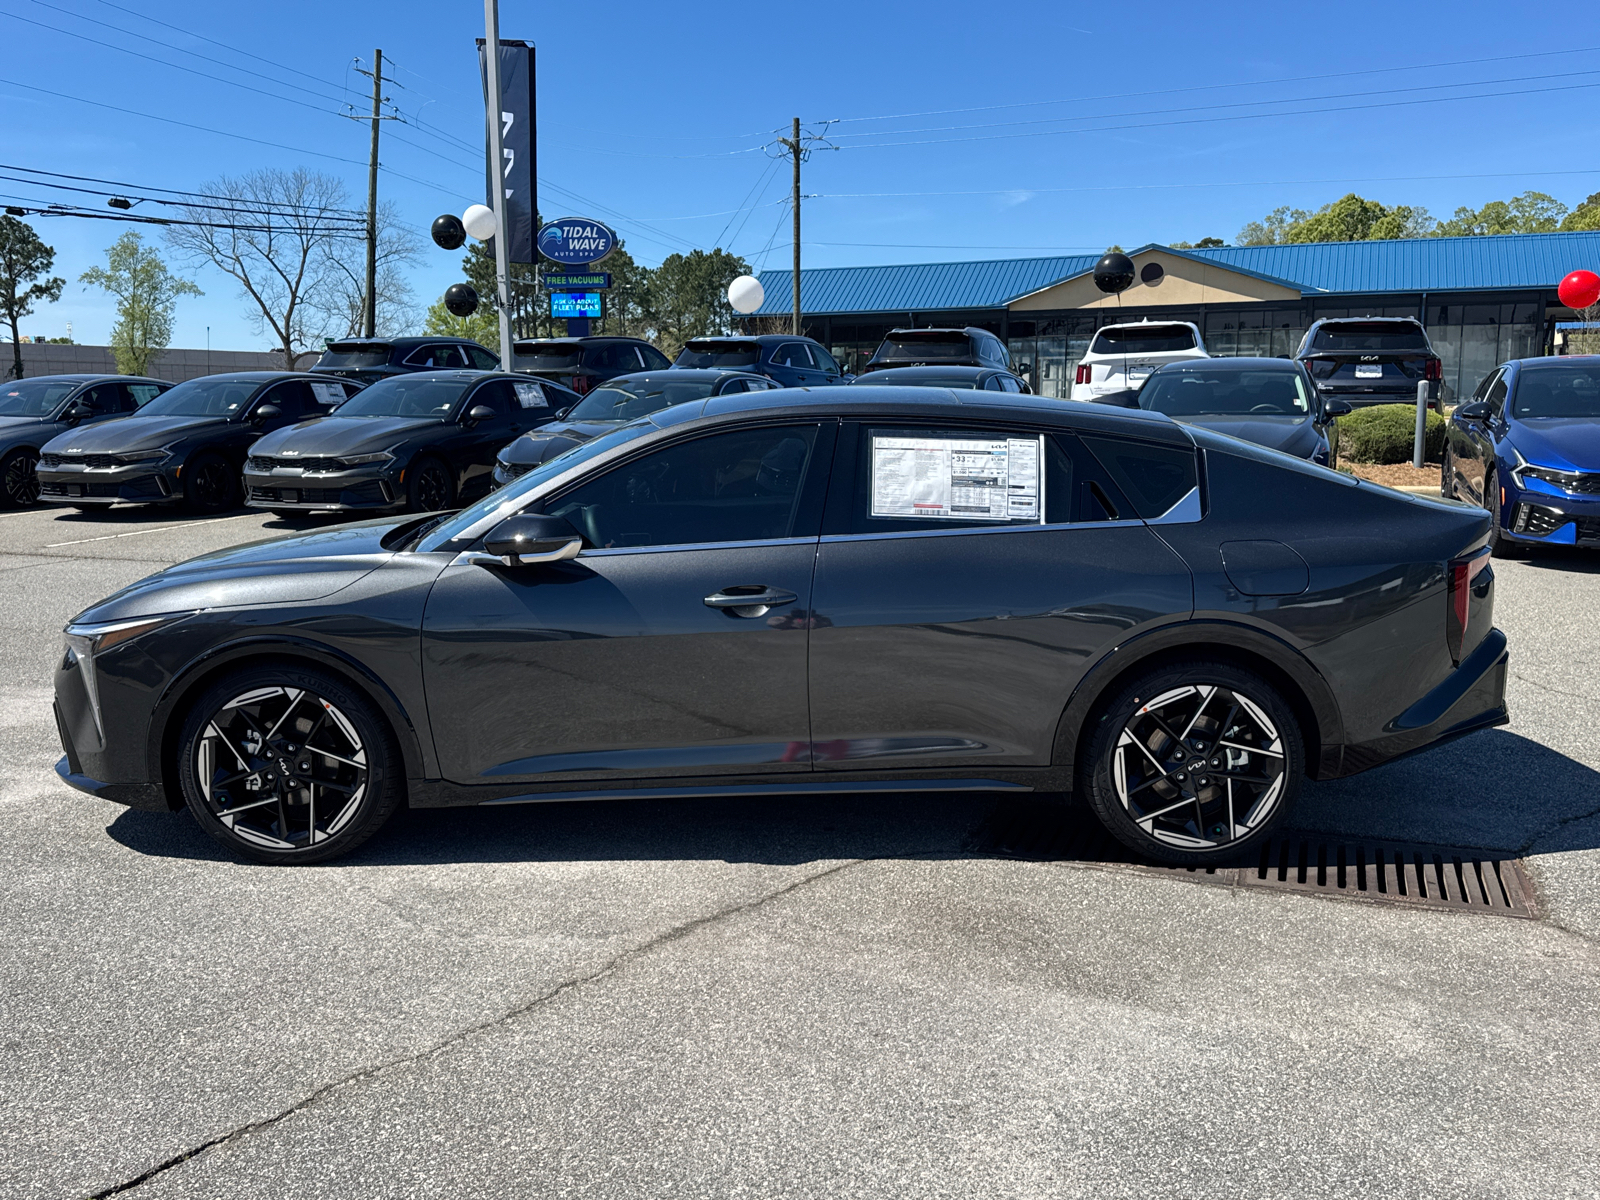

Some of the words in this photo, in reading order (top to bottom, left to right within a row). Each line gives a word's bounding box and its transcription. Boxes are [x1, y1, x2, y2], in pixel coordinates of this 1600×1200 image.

[563, 226, 599, 238] TIDAL
[569, 238, 606, 250] WAVE
[546, 276, 567, 285] FREE
[568, 275, 605, 284] VACUUMS
[956, 455, 966, 463] 33
[297, 675, 347, 704] KUMHO
[1146, 843, 1199, 862] KUMHO
